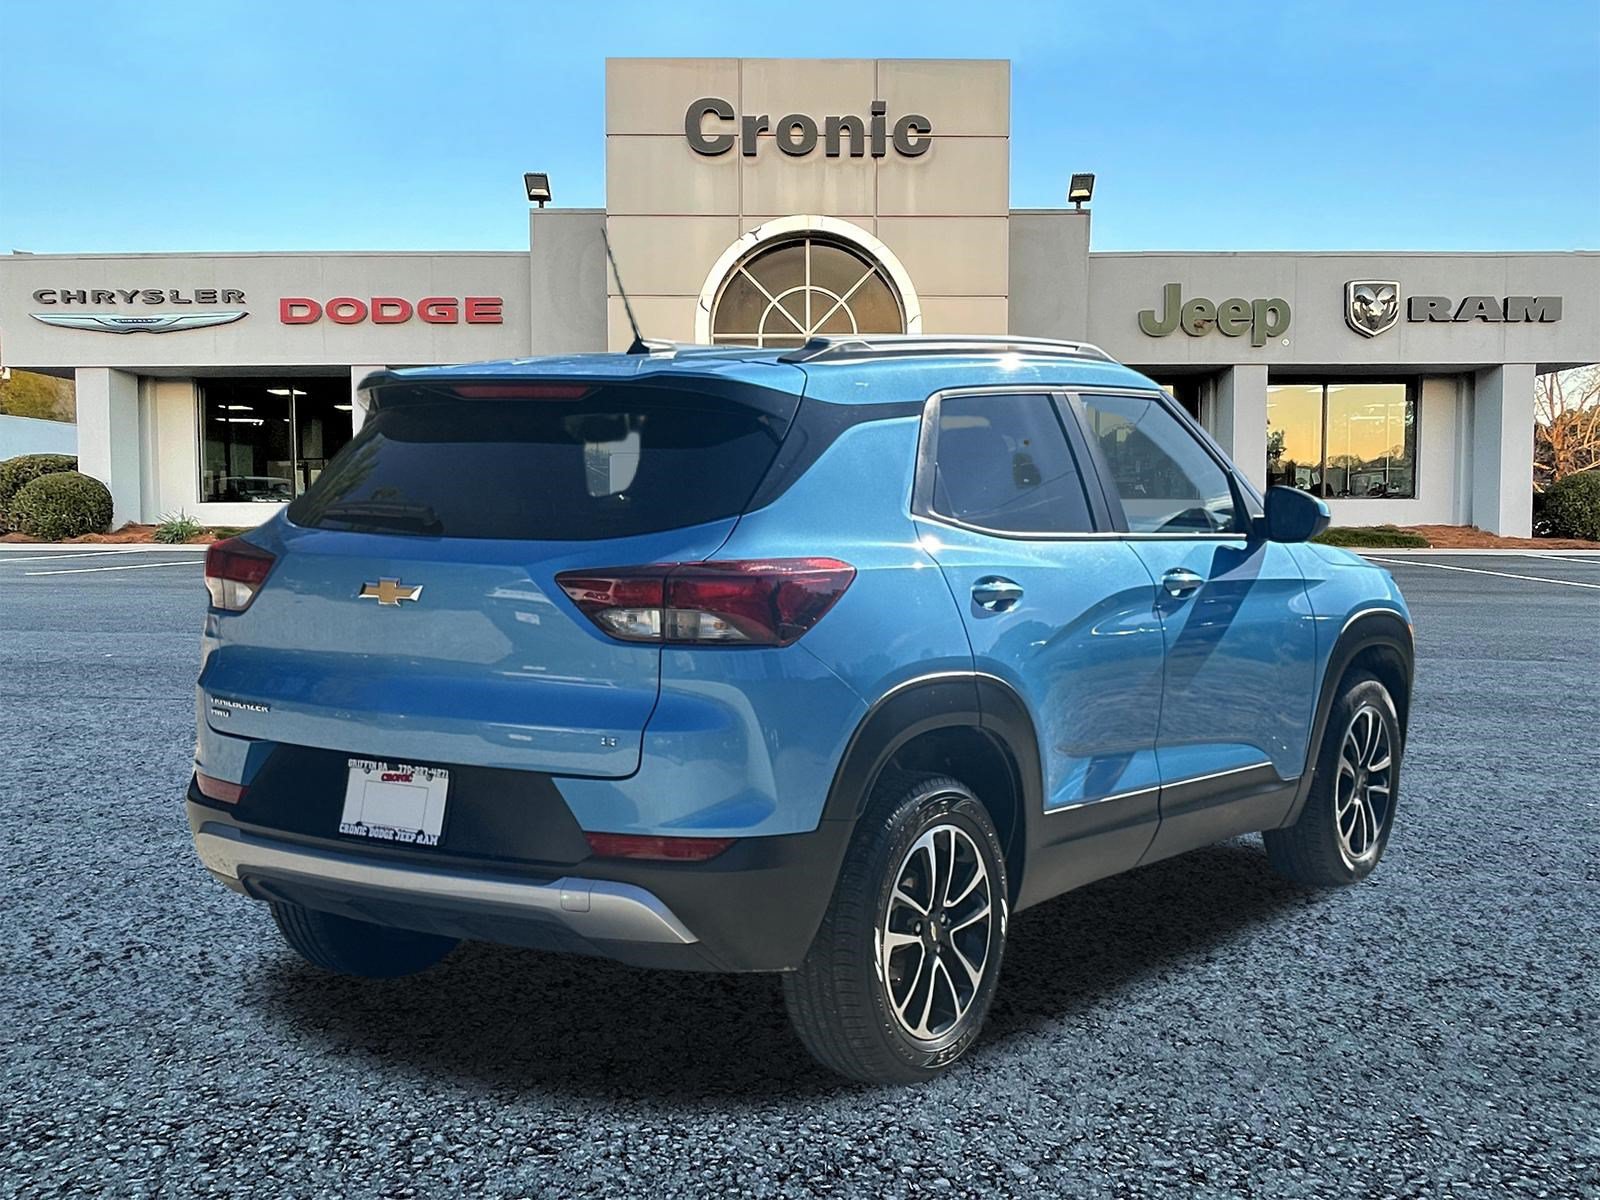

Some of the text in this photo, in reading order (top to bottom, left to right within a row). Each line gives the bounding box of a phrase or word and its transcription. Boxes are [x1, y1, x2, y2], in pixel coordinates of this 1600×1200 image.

[685, 97, 932, 158] Cronic
[32, 287, 246, 306] CHRYSLER
[279, 296, 504, 325] DODGE
[1408, 296, 1563, 324] RAM
[1138, 283, 1291, 347] Jeep
[339, 823, 439, 846] CRONIC DODGE JEEP RAM
